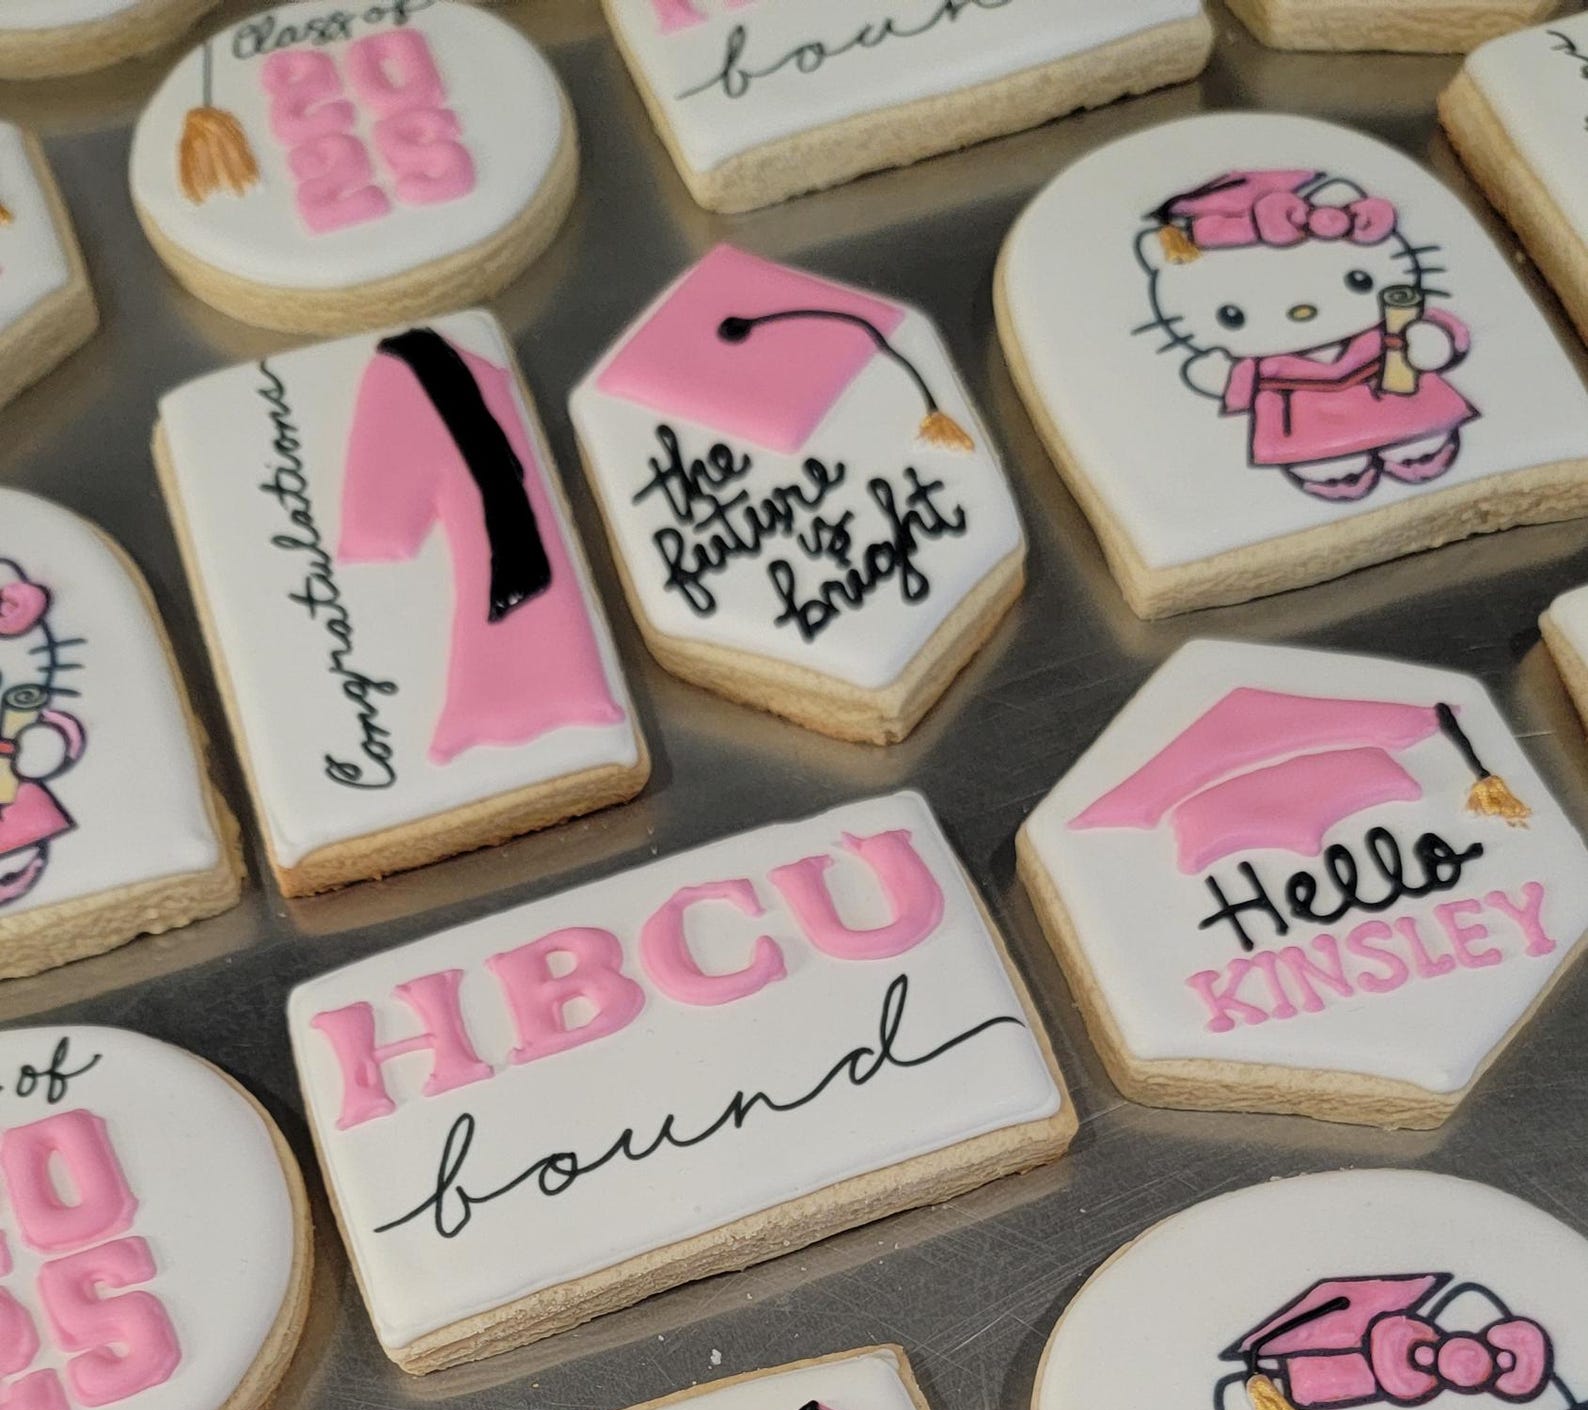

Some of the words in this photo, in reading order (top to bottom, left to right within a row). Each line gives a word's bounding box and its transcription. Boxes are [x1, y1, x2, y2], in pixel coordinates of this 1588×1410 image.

[232, 14, 353, 60] Class
[260, 28, 446, 148] 20
[673, 0, 1013, 99] boun
[286, 106, 477, 235] 25
[632, 423, 752, 524] the
[653, 457, 846, 617] future
[254, 358, 400, 790] Congratulations
[767, 466, 967, 644] bright
[799, 510, 855, 567] is
[1198, 825, 1485, 953] Hello
[310, 828, 945, 1131] HBCU
[1185, 880, 1557, 1034] KINSLEY
[15, 1036, 102, 1104] of
[373, 973, 1027, 1239] bound
[0, 1108, 139, 1279] 0
